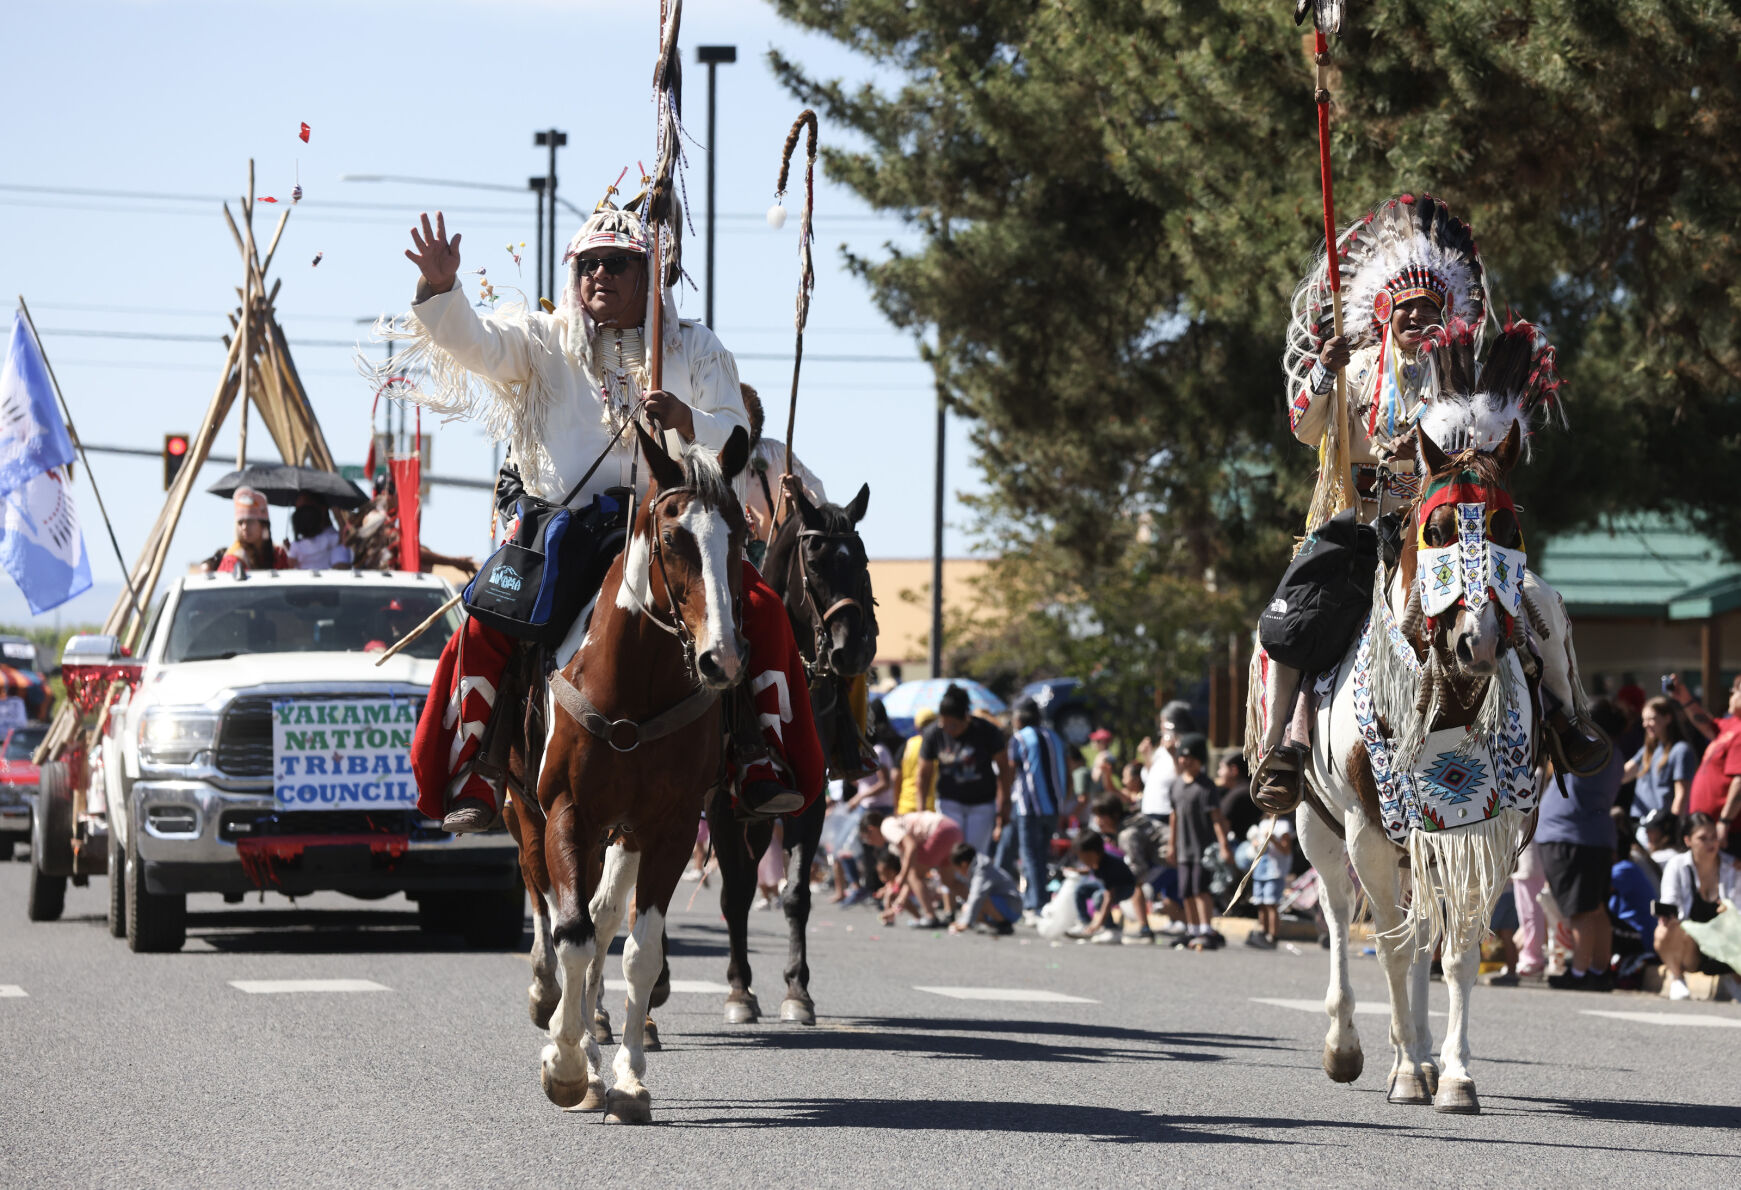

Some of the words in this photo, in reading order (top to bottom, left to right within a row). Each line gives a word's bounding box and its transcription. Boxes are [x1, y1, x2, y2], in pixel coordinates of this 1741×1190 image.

[276, 704, 414, 725] YAKAMA
[285, 729, 412, 750] NATION
[280, 755, 413, 775] TRIBAL
[276, 782, 415, 803] COUNCIL
